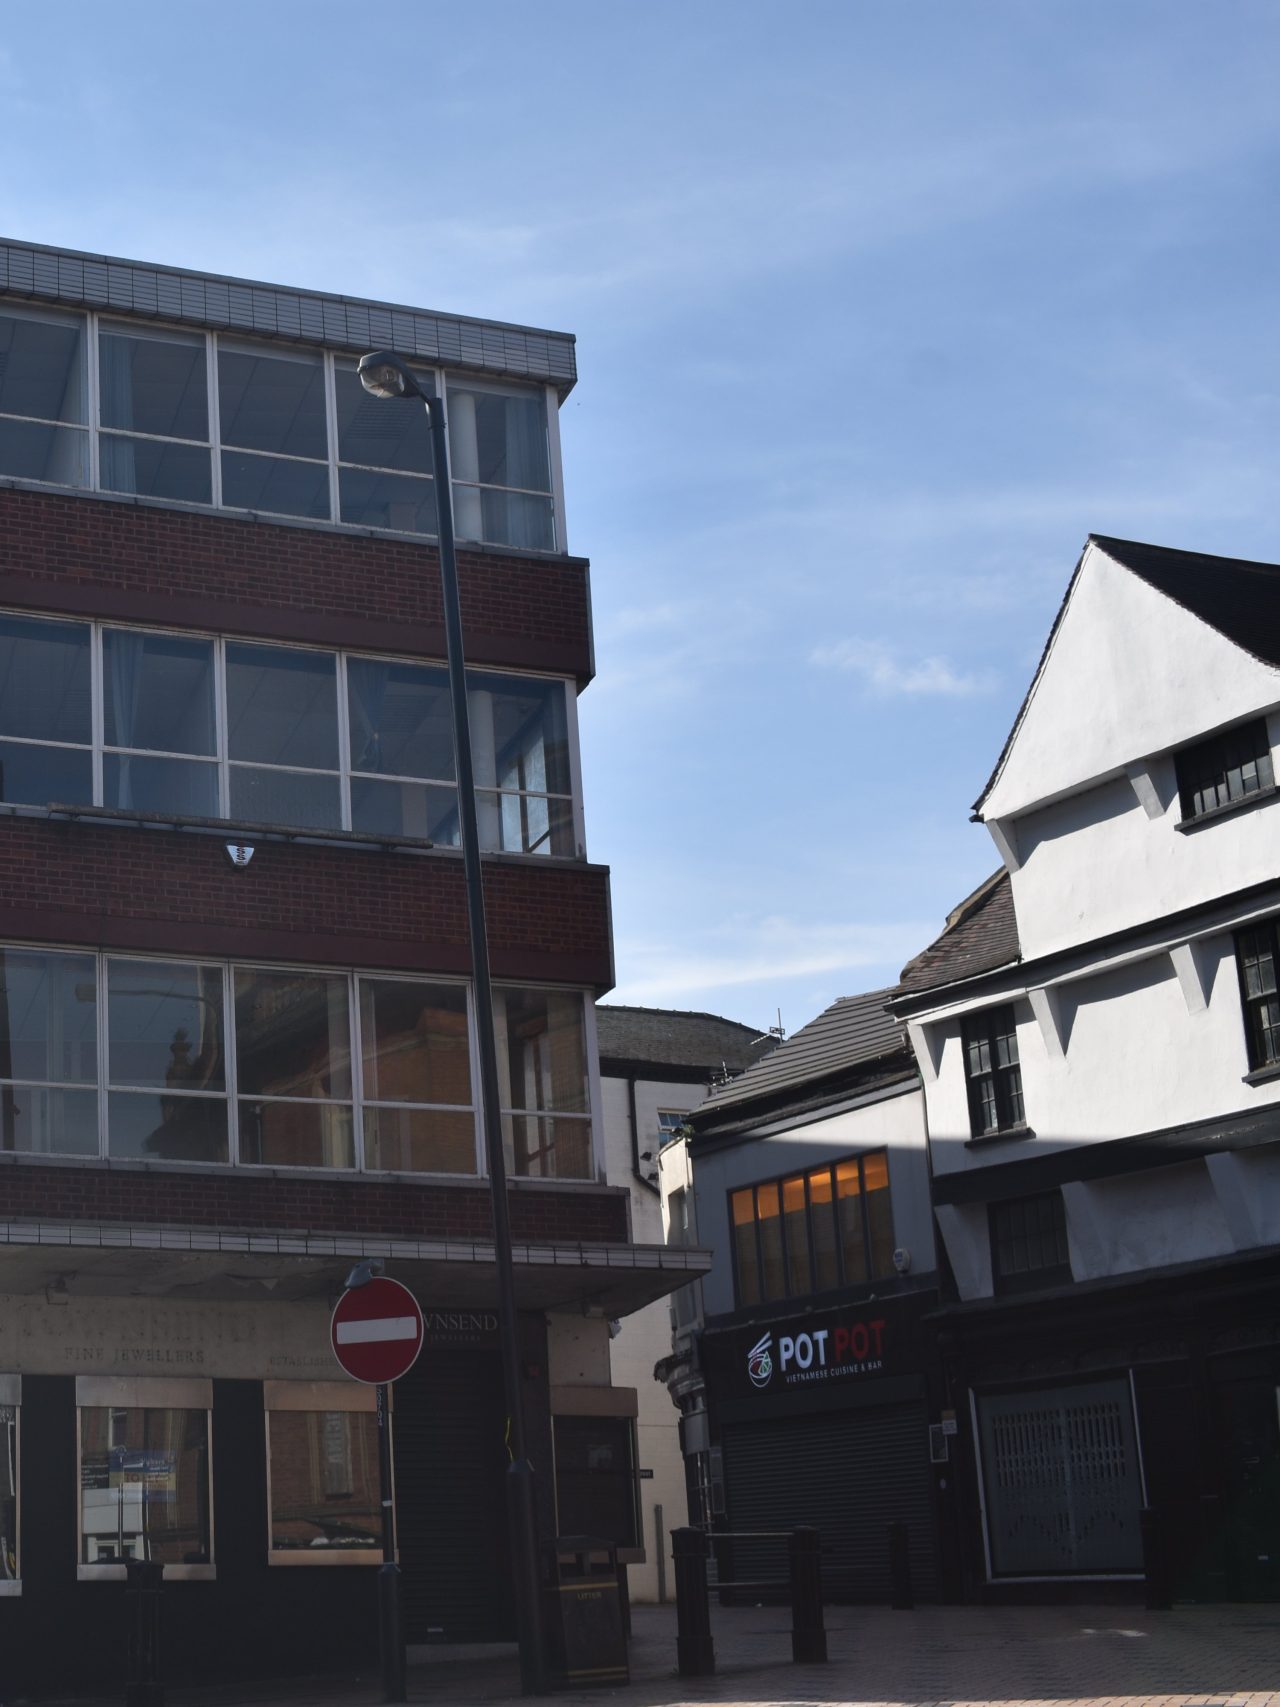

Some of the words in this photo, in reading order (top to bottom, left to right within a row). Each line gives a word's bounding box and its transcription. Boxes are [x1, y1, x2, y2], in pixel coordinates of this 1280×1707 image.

[64, 1347, 104, 1361] FINE
[113, 1348, 206, 1364] JEWELLERS
[779, 1329, 829, 1372] POT
[833, 1319, 886, 1361] POT
[270, 1354, 337, 1367] ESTABLISHE
[785, 1370, 828, 1384] VIETNAMESE
[830, 1364, 860, 1377] CUISINE
[867, 1359, 883, 1371] BAR
